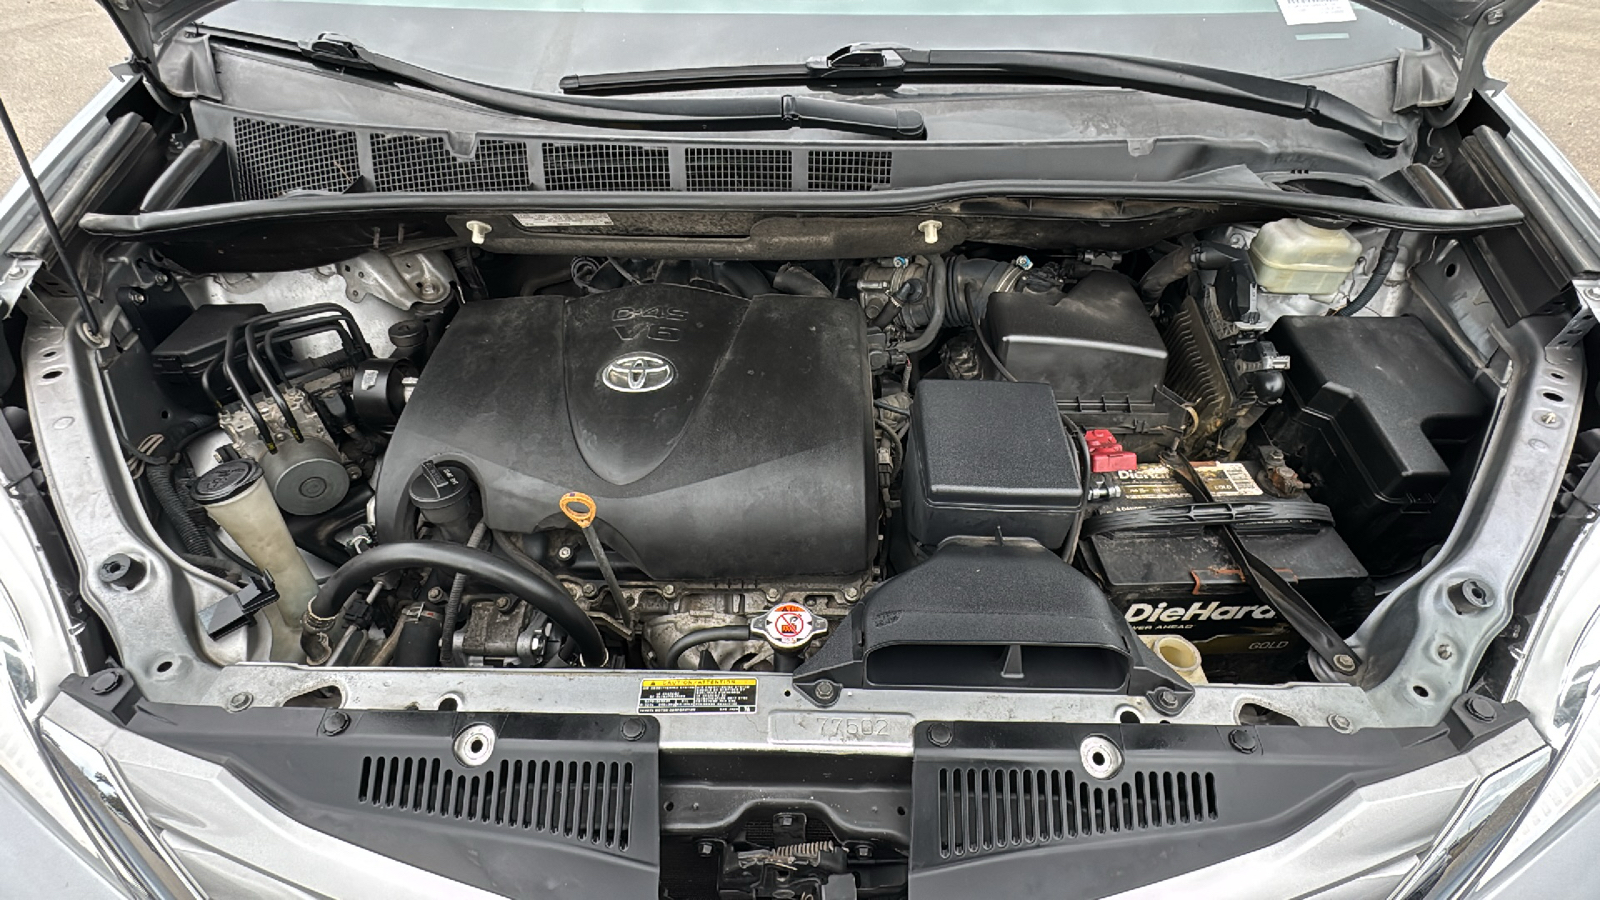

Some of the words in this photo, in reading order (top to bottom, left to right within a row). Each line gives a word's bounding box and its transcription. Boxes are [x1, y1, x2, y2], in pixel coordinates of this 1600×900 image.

[613, 322, 681, 342] V6
[1248, 640, 1290, 650] GOLD
[816, 717, 889, 736] 77502
